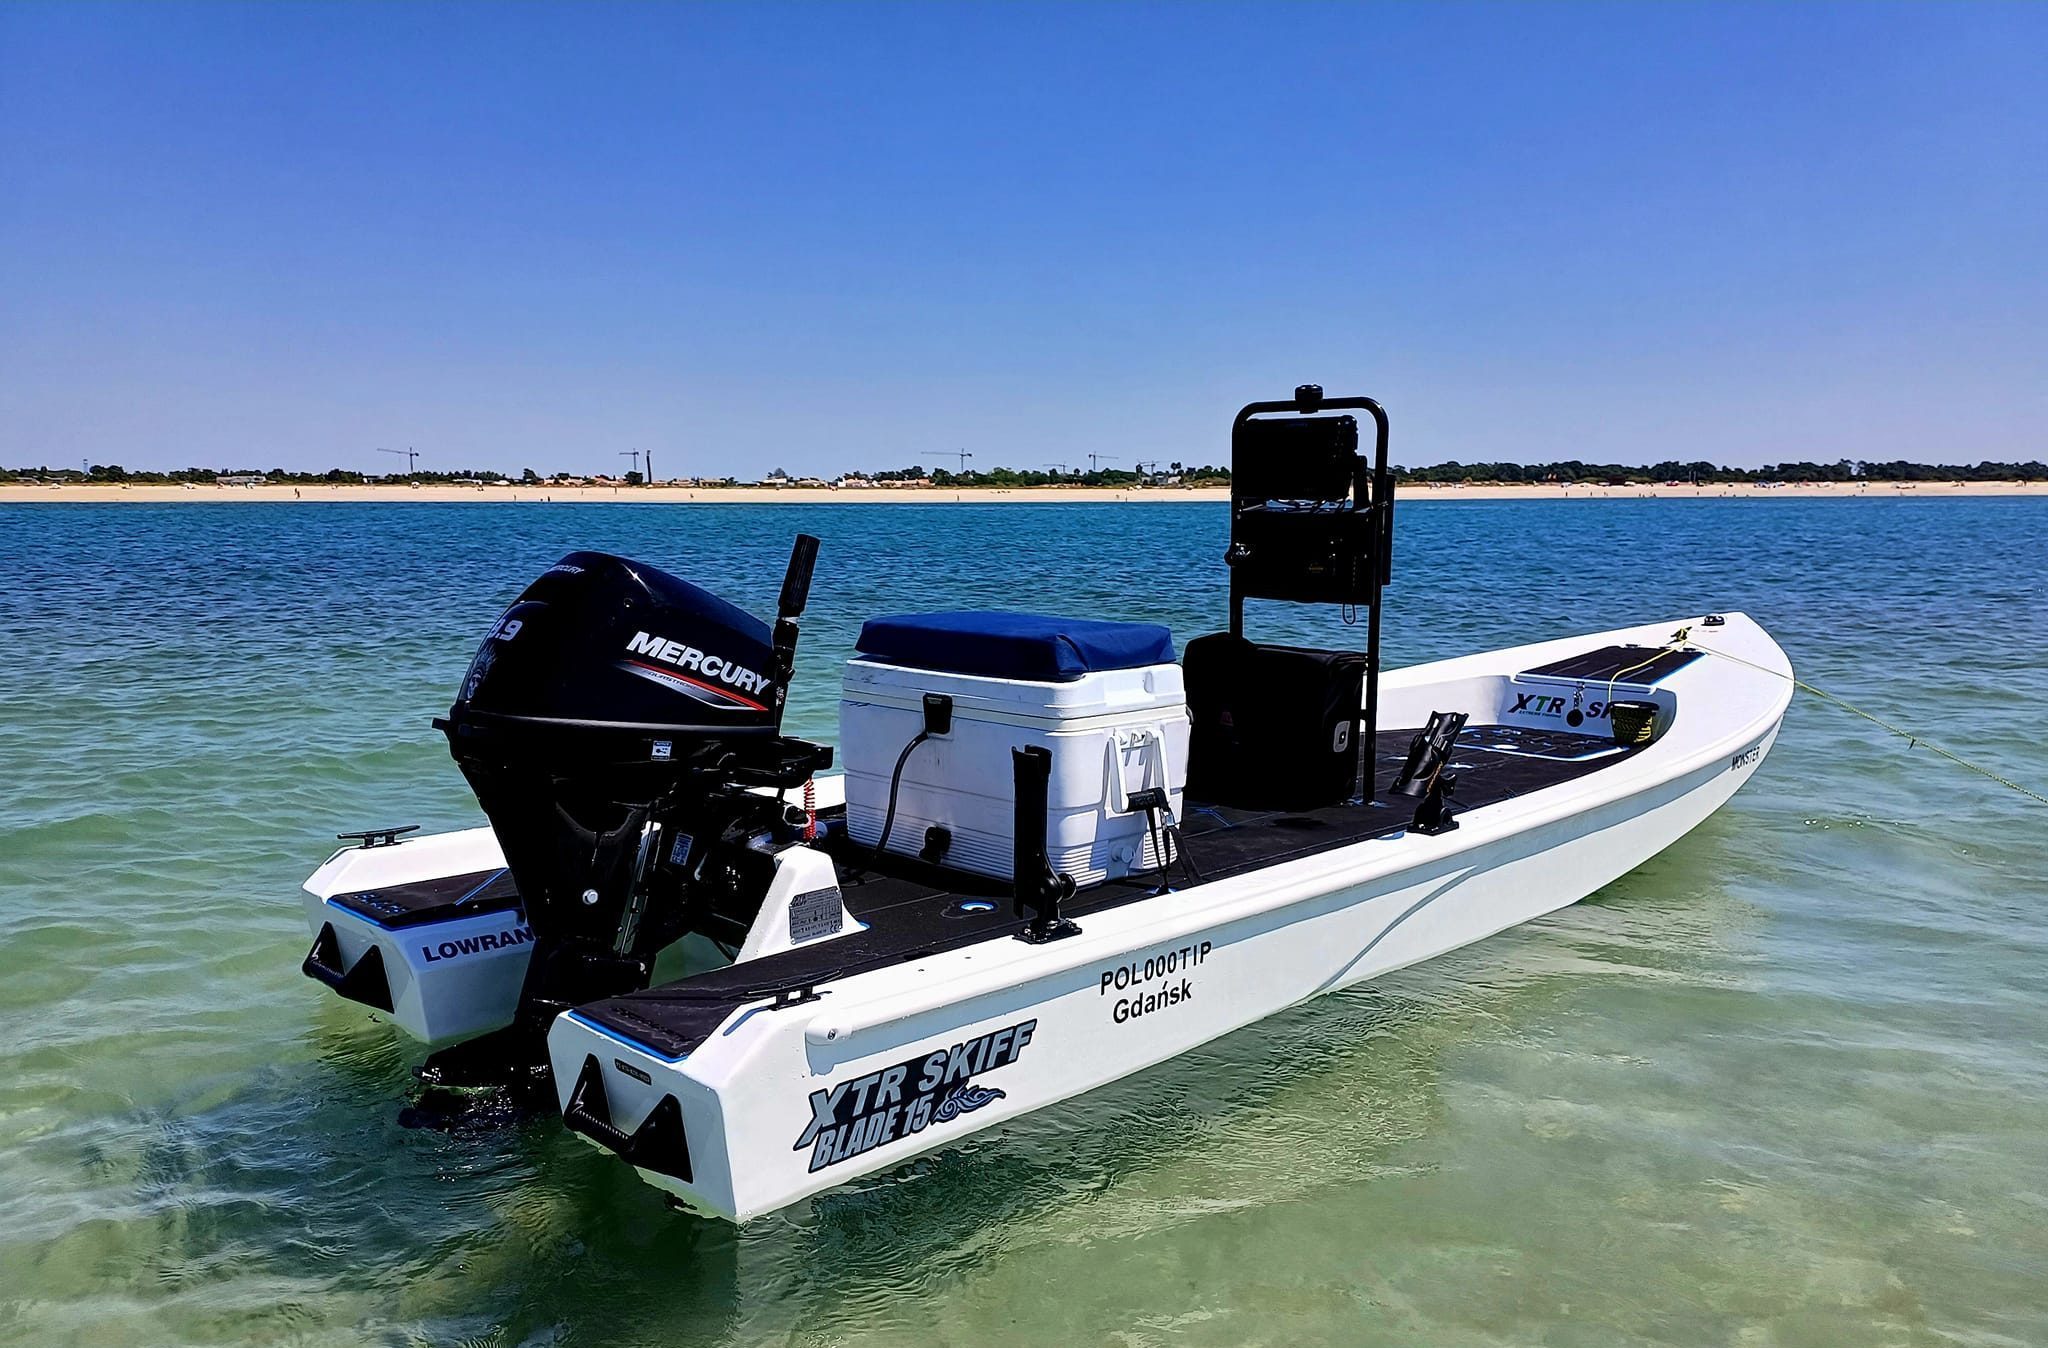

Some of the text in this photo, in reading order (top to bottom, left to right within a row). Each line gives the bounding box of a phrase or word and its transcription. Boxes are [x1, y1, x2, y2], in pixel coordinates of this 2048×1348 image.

[626, 631, 771, 695] MERCURY
[1508, 693, 1566, 714] XTR
[1731, 746, 1760, 771] MONSTER
[422, 927, 534, 962] LOWRAN
[1113, 978, 1192, 1024] Gdańsk
[795, 1020, 1036, 1151] XTR SKIFF
[809, 1093, 935, 1173] BLADE 15
